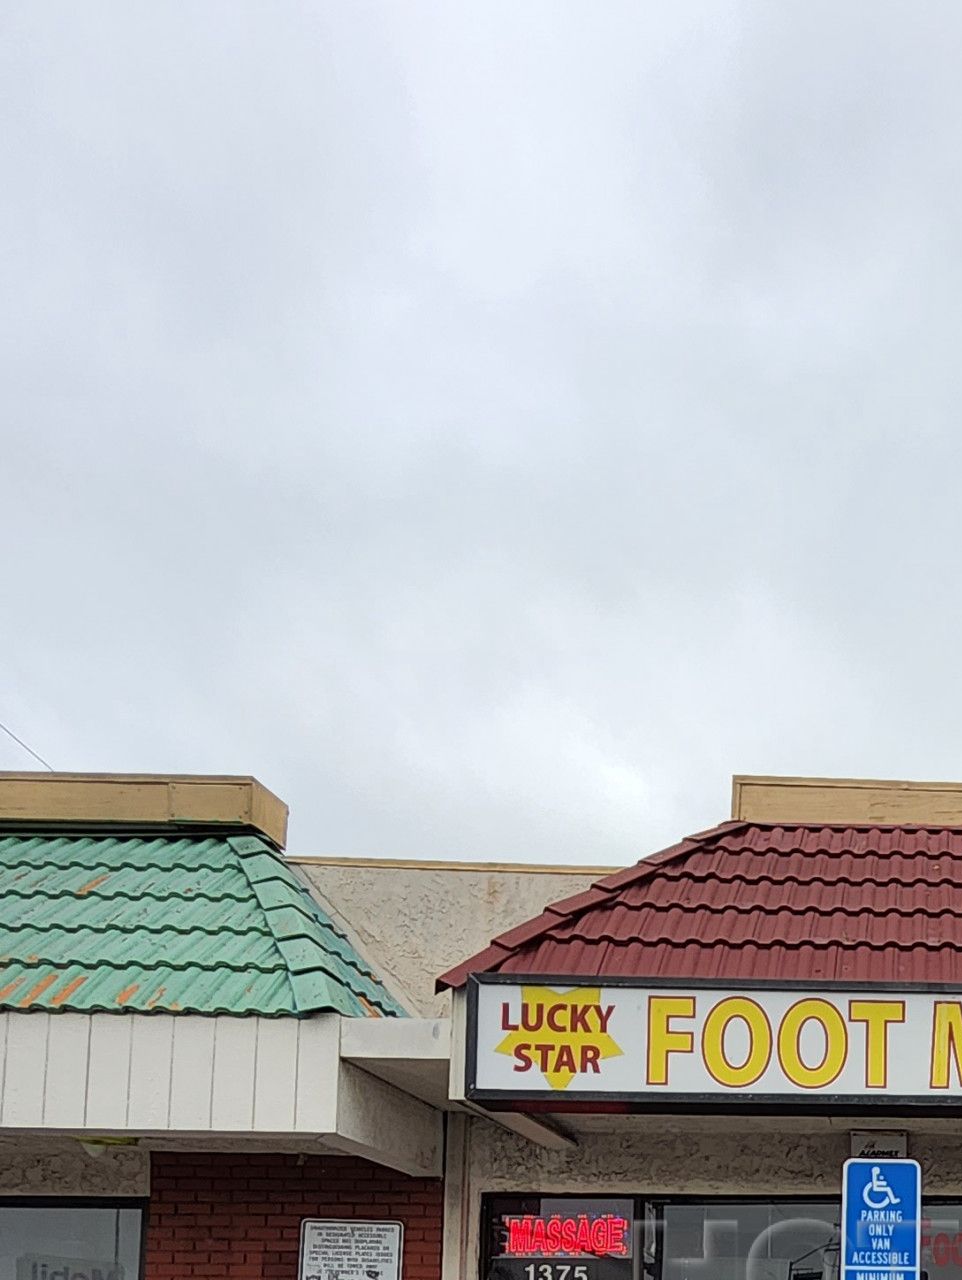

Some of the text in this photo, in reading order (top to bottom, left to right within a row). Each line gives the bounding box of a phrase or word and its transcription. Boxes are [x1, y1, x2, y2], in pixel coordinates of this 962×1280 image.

[501, 1002, 616, 1033] LUCKY
[645, 995, 906, 1089] FOOT
[513, 1043, 601, 1074] STAR
[860, 1210, 903, 1222] PARKING
[508, 1218, 625, 1253] MASSAGE
[868, 1224, 894, 1237] ONLY
[871, 1238, 891, 1250] VAN
[852, 1252, 910, 1265] ACCESSIBLE
